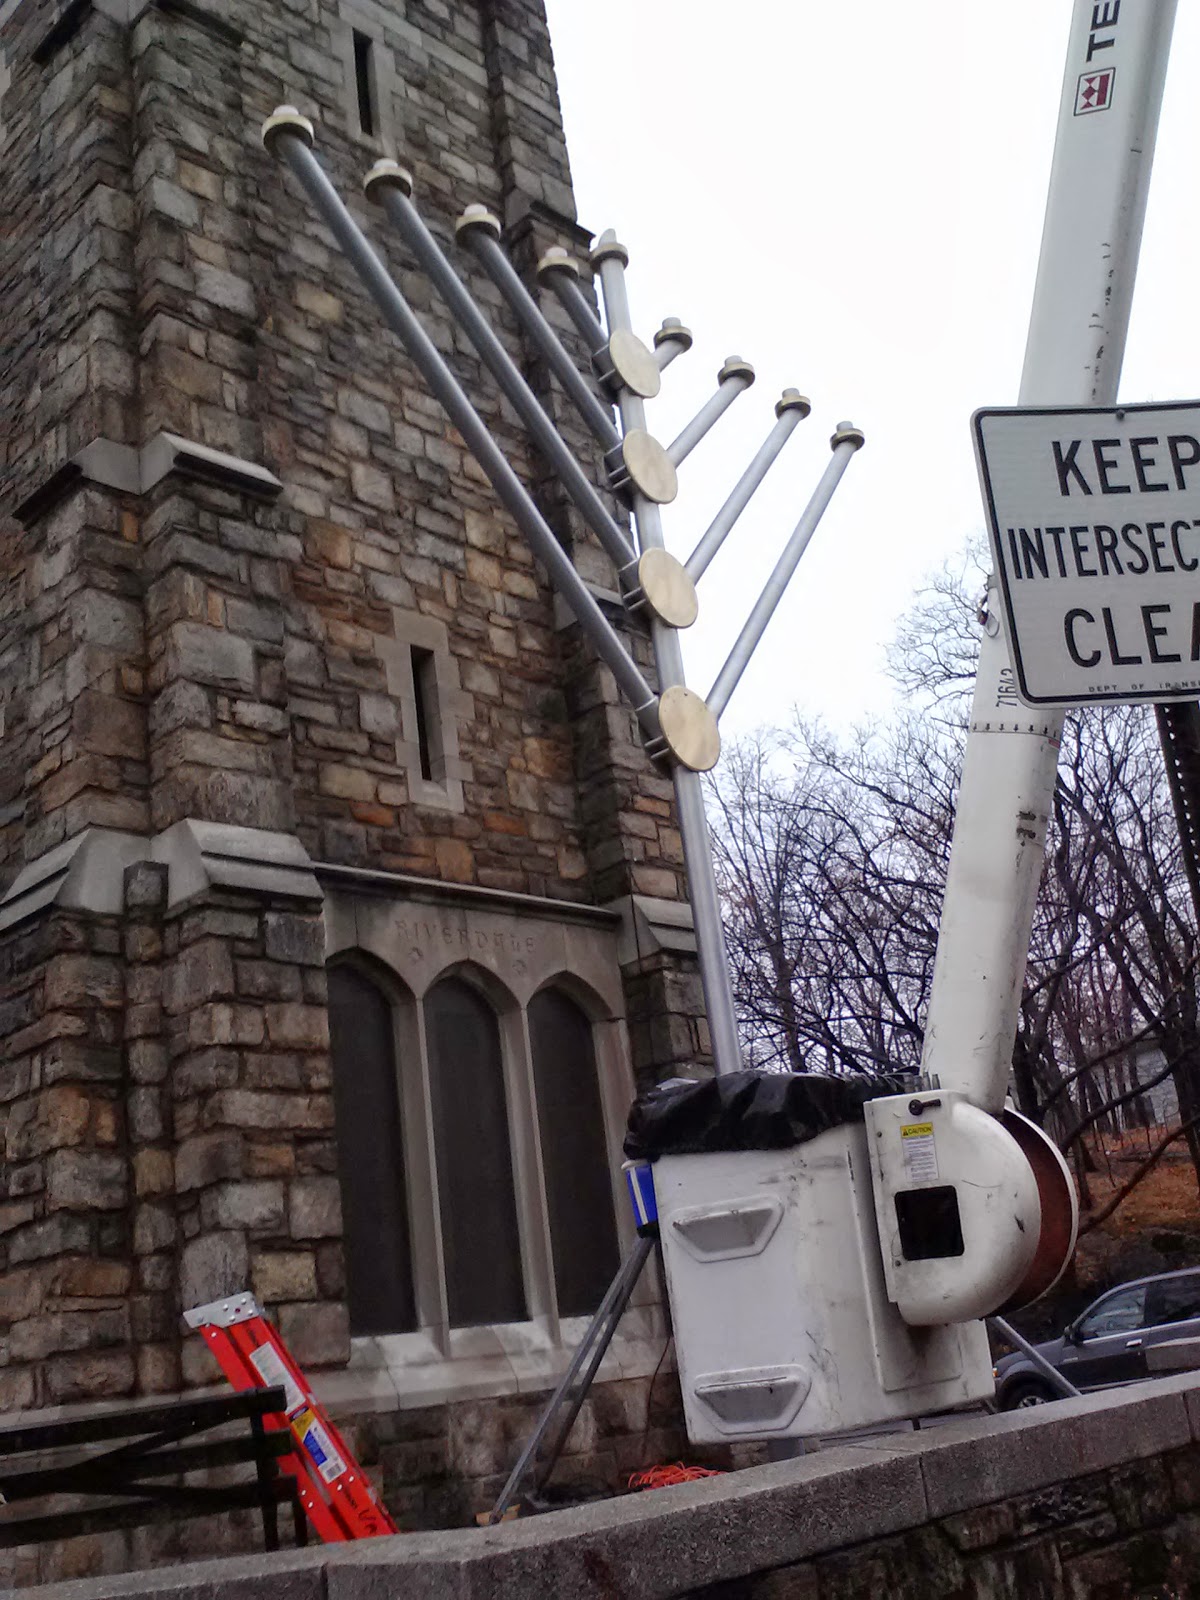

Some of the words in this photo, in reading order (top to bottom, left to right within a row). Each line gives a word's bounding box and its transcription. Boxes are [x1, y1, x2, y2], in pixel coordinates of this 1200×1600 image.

[1052, 435, 1200, 496] KEEP
[1088, 684, 1118, 693] DEPT
[1131, 683, 1144, 691] OF
[1158, 680, 1200, 690] TRANS
[908, 1126, 932, 1135] CAUTION
